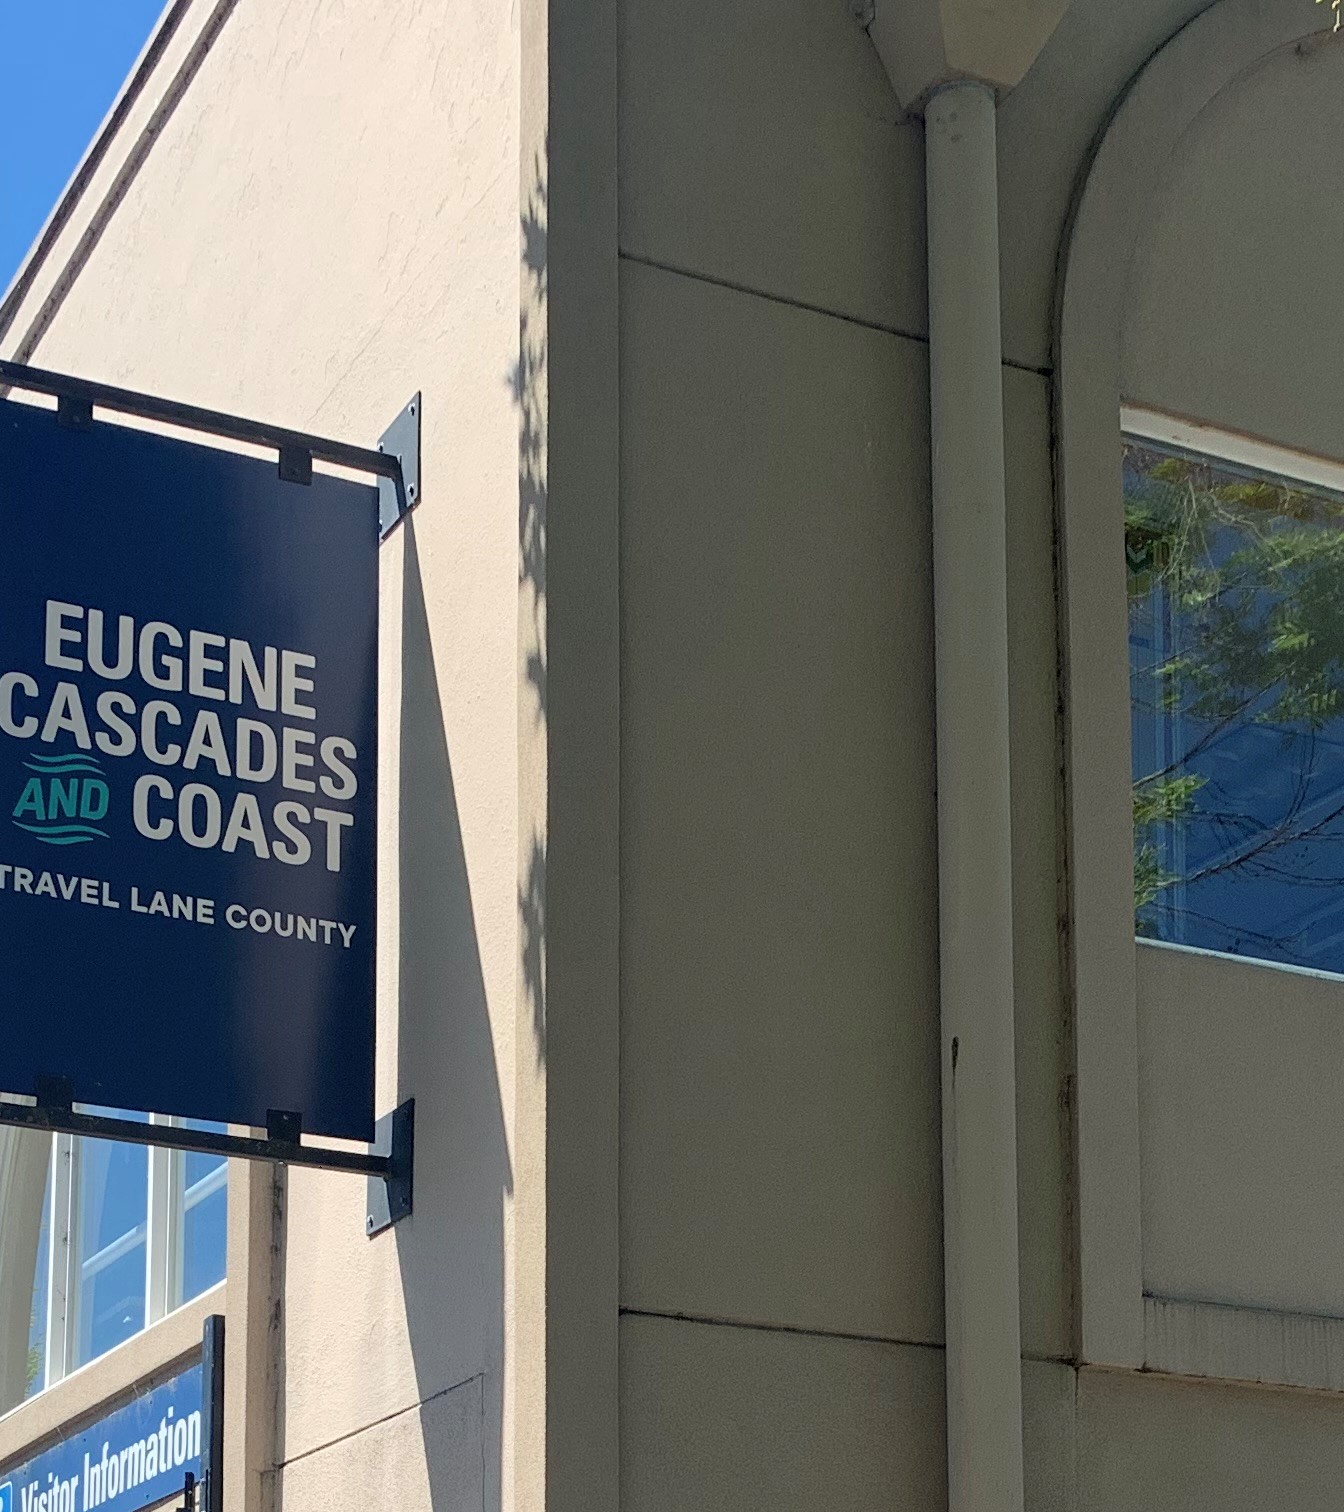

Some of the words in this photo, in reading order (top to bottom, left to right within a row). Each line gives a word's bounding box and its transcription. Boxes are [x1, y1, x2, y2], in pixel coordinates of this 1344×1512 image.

[44, 599, 316, 720] EUGENE
[12, 777, 109, 821] AND
[132, 774, 354, 872] COAST
[130, 886, 215, 925] LANE
[225, 904, 356, 948] COUNTY
[83, 1406, 201, 1512] Information
